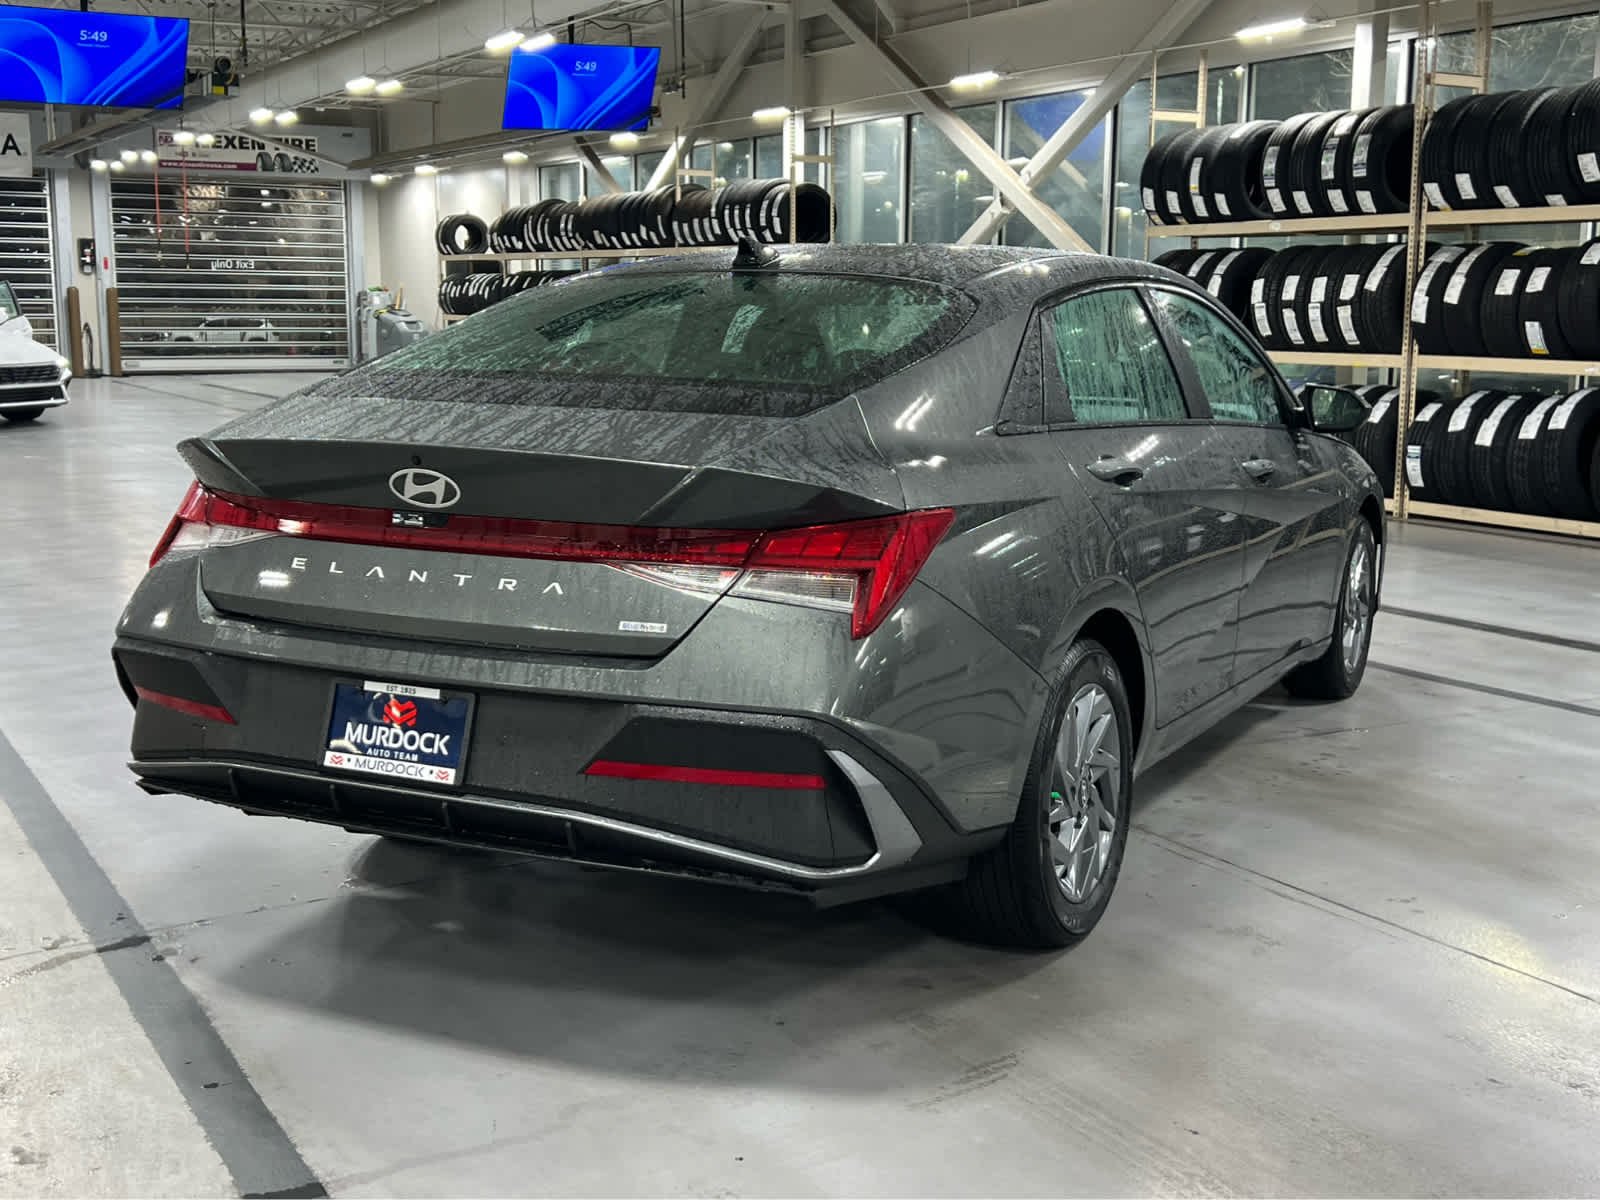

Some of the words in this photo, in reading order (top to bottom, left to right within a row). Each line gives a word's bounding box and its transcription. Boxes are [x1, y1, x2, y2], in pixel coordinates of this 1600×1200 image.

[80, 30, 108, 42] 5:49
[575, 61, 597, 71] 5:49
[1, 133, 22, 155] A
[196, 134, 265, 150] EXEN
[291, 557, 564, 595] ELANTRA
[386, 684, 398, 692] EST
[344, 721, 451, 756] MURDOCK
[366, 748, 391, 758] AUTO
[394, 751, 419, 762] TEAM
[354, 757, 425, 778] MURDOCK
